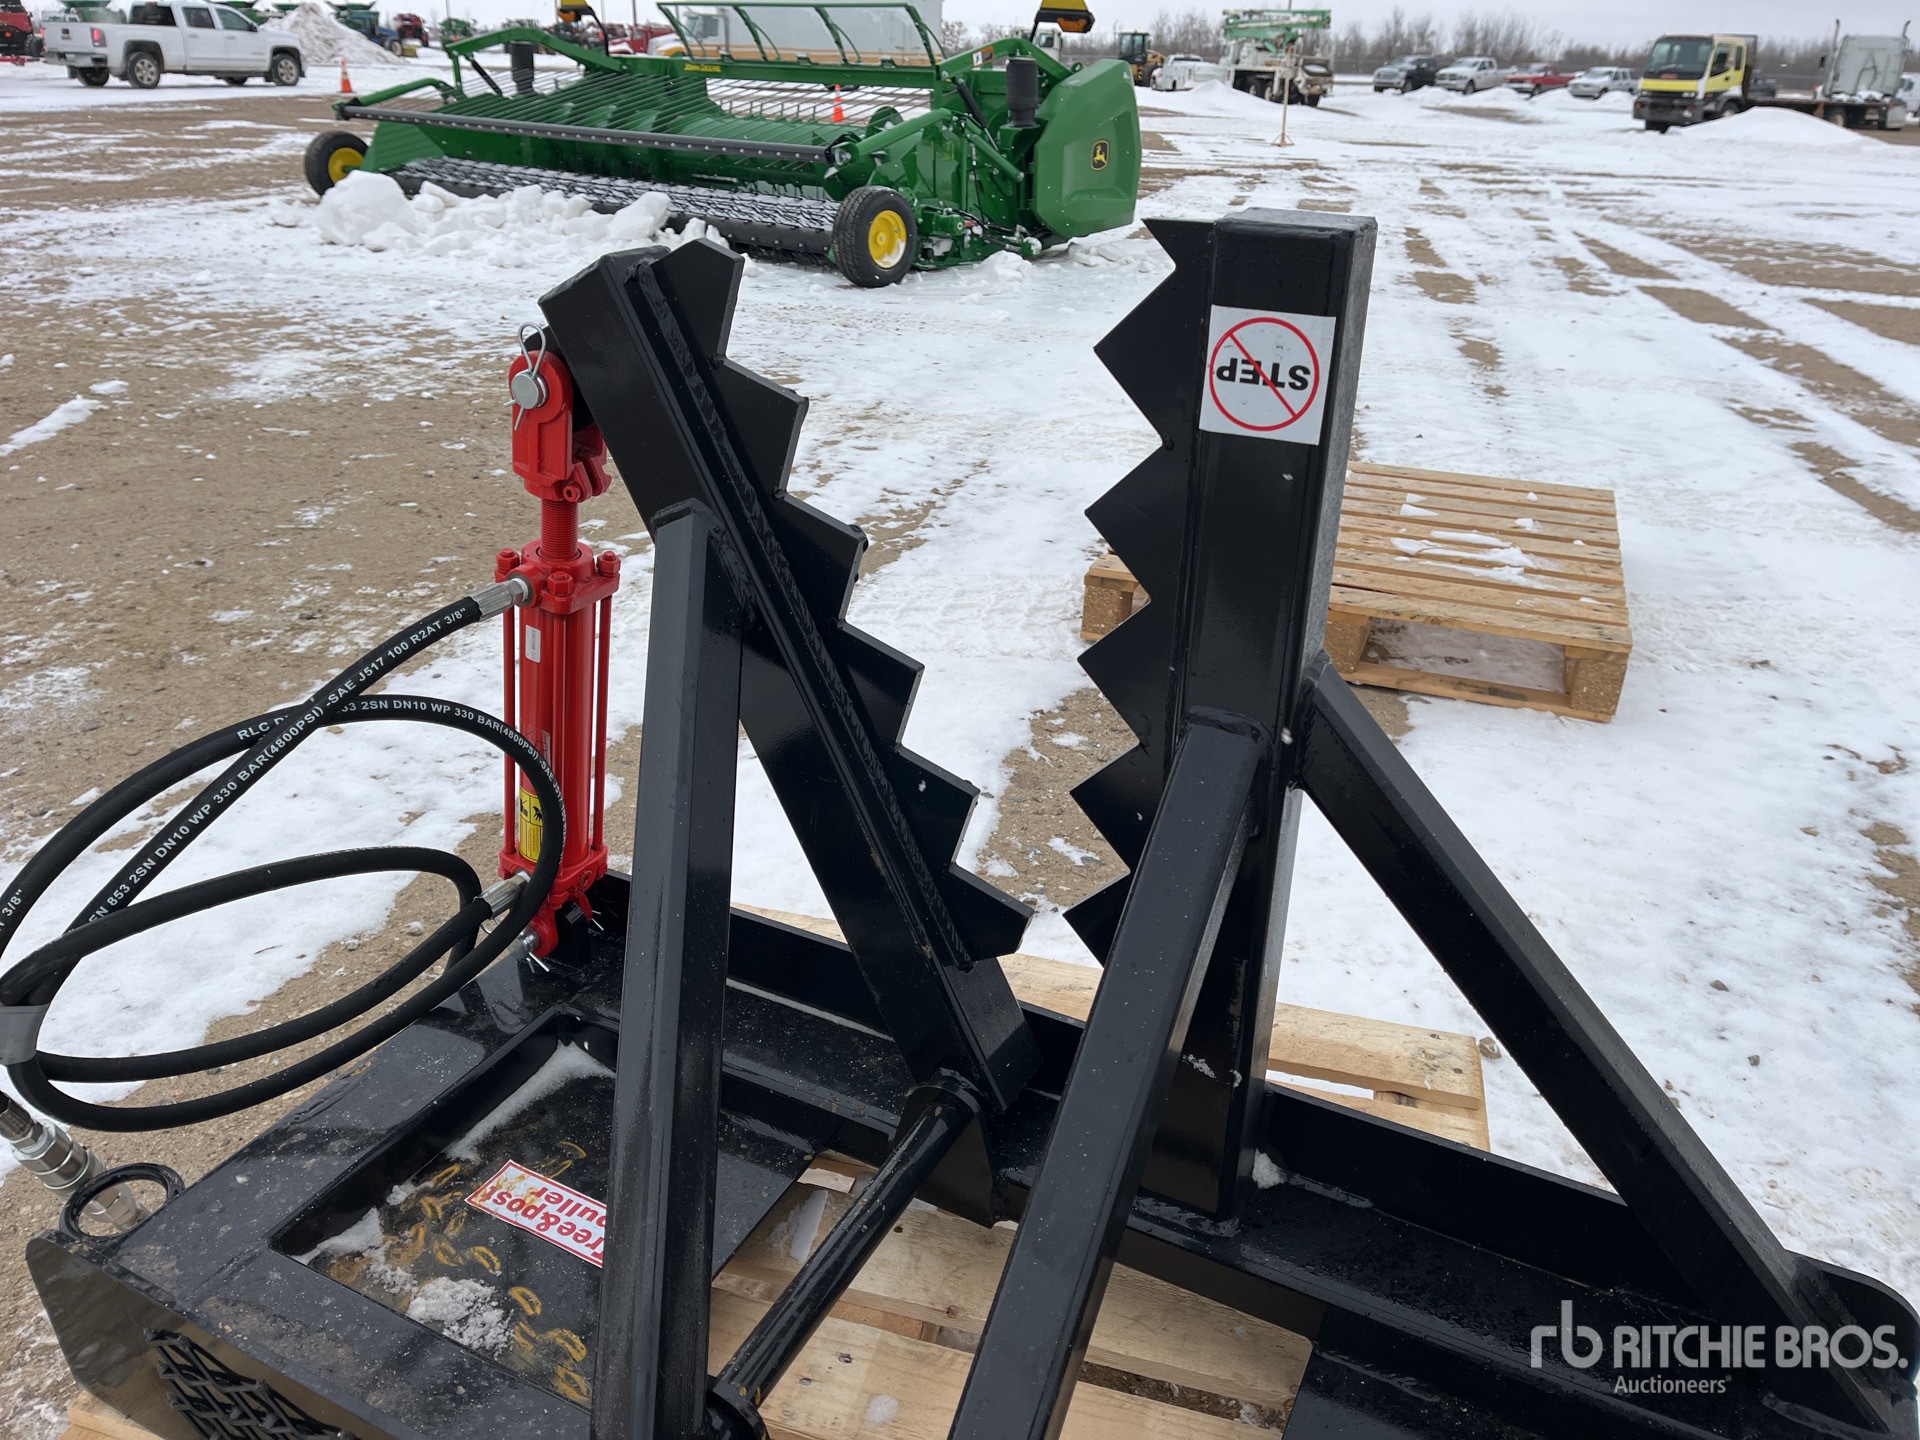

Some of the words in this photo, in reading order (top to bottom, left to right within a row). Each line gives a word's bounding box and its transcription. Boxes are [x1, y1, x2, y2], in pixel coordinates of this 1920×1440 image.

[1216, 357, 1311, 391] STEP
[361, 700, 389, 710] 2SN
[393, 700, 427, 711] DN10
[430, 702, 451, 714] WP
[454, 707, 474, 720] 330
[236, 722, 270, 740] RLC
[107, 884, 130, 906] 853
[129, 858, 156, 884] 2SN
[155, 825, 190, 858] DN10
[188, 804, 212, 827] WP
[213, 781, 237, 804] 330
[358, 656, 384, 682] J517
[387, 641, 409, 659] 100
[410, 621, 442, 645] R2AT
